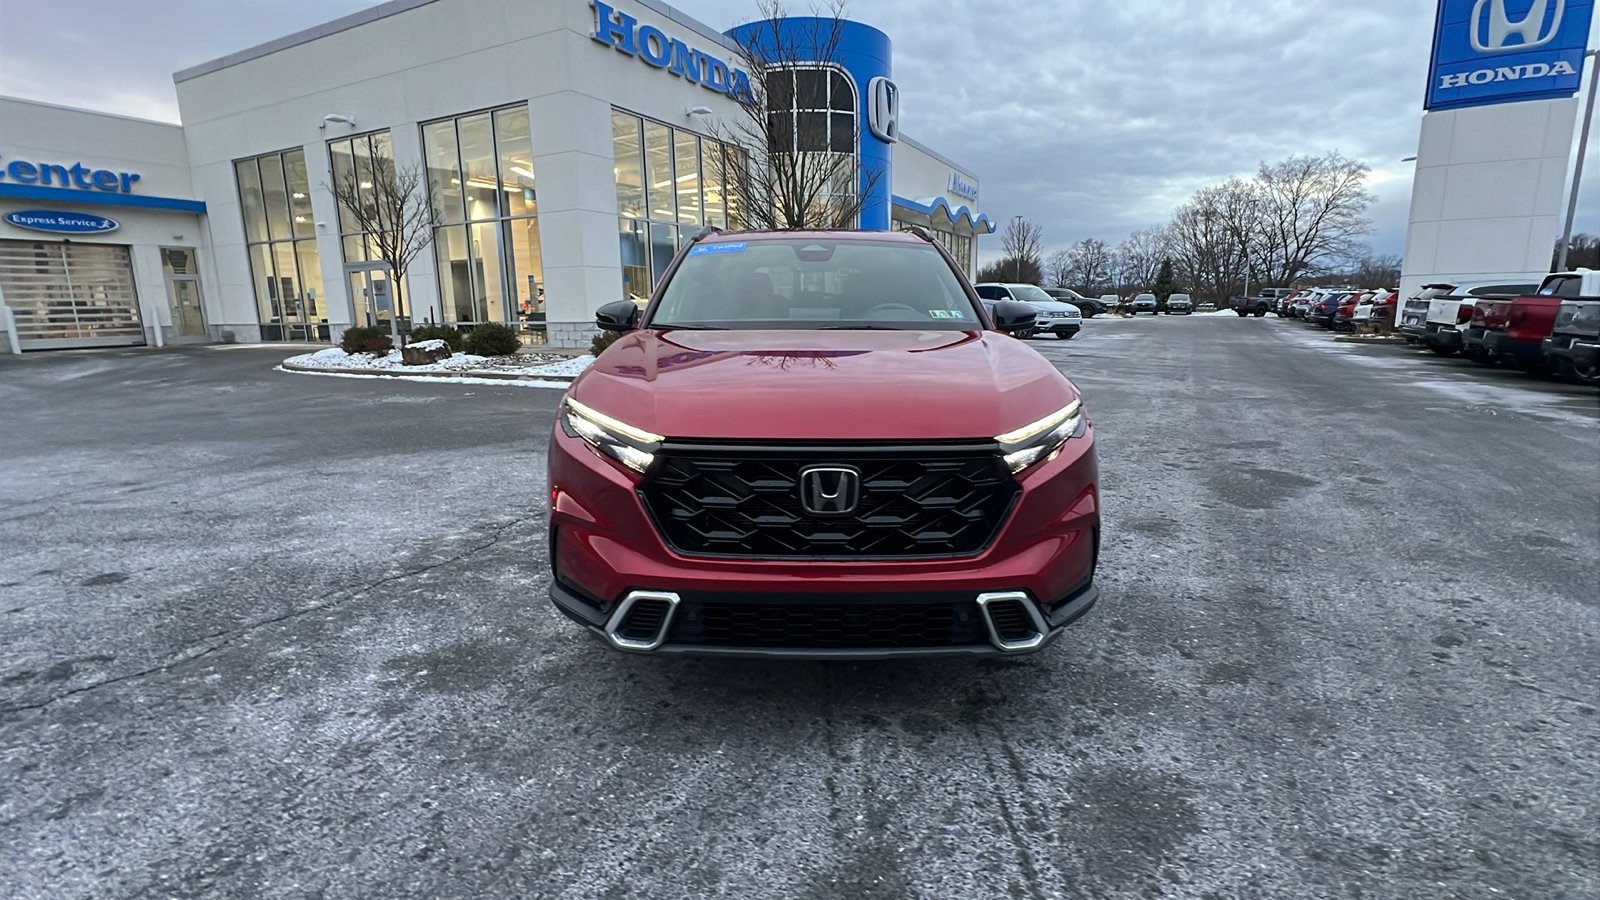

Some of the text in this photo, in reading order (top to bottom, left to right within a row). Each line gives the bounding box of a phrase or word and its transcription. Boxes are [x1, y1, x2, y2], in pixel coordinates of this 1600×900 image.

[590, 0, 758, 104] HONDA
[1439, 60, 1577, 89] HONDA
[0, 159, 141, 192] enter
[12, 214, 97, 228] Express Service
